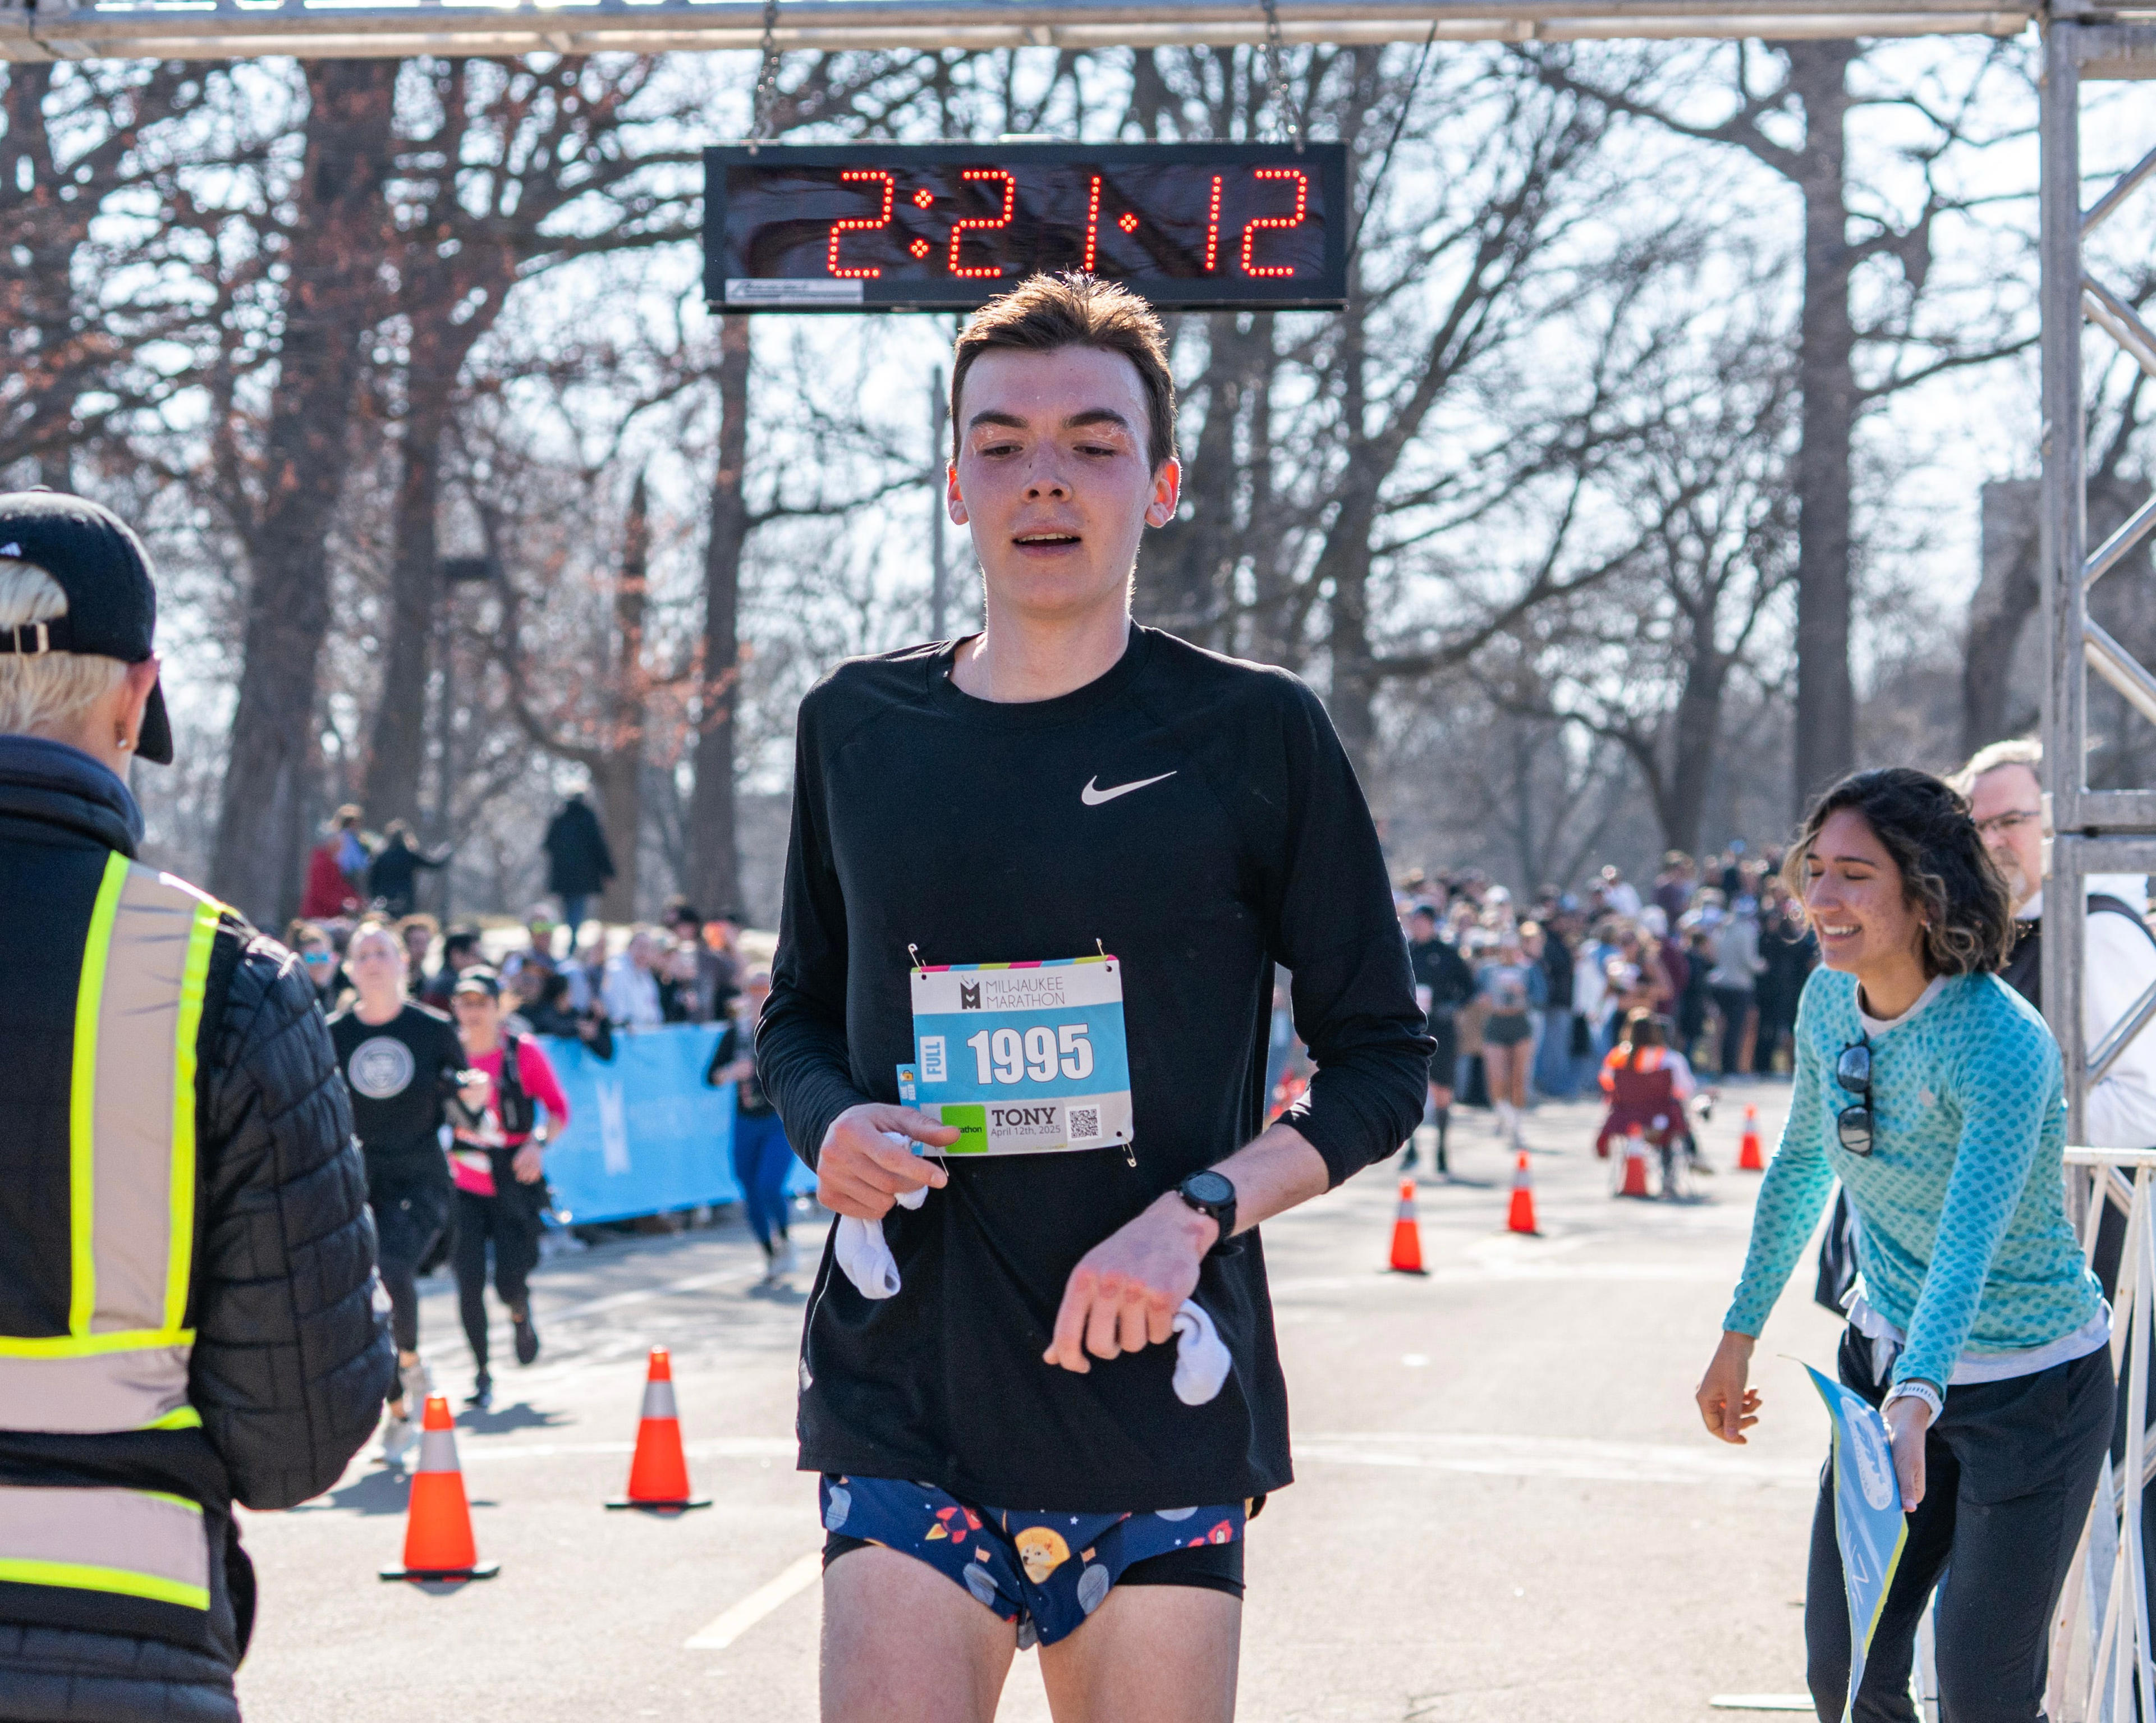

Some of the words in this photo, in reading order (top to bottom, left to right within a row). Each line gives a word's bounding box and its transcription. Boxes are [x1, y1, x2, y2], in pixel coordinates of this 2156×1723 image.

[985, 977, 1064, 994] MILWAUKEE
[987, 992, 1065, 1009] MARATHON
[925, 1041, 942, 1075] FULL
[966, 1023, 1094, 1085] 1995
[991, 1107, 1057, 1127] TONY
[991, 1126, 1011, 1138] April
[1015, 1126, 1036, 1135] 12th,
[1039, 1125, 1061, 1134] 2025
